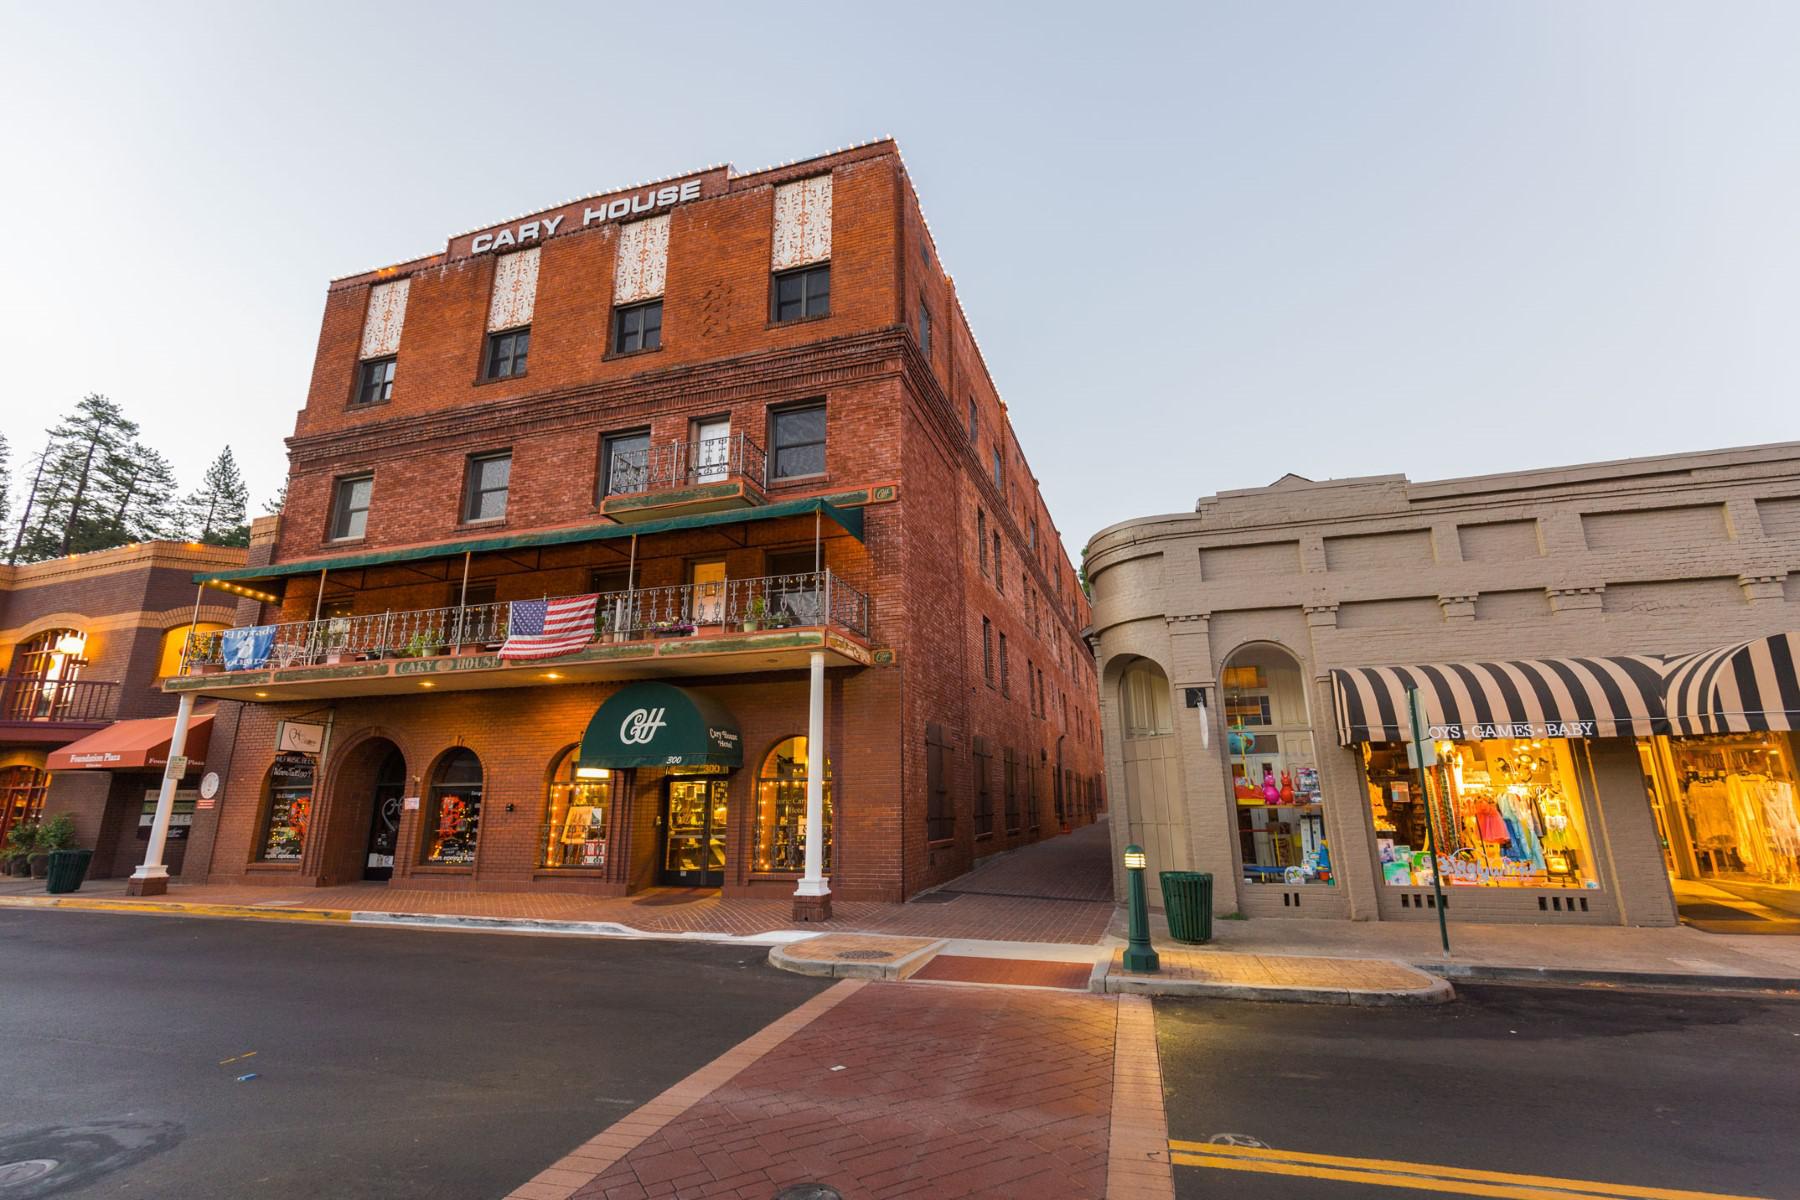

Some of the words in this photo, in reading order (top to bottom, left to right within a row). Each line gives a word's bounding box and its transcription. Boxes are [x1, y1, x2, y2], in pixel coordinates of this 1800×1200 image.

[471, 214, 565, 254] CARY
[582, 179, 702, 226] HOUSE
[398, 660, 434, 674] CARY
[456, 656, 498, 670] HOUSE
[1429, 724, 1462, 739] OYS
[1471, 723, 1536, 739] GAMES
[1545, 721, 1594, 737] BABY
[70, 754, 103, 763] Foundation
[104, 753, 121, 762] Plaza
[666, 756, 682, 764] 300
